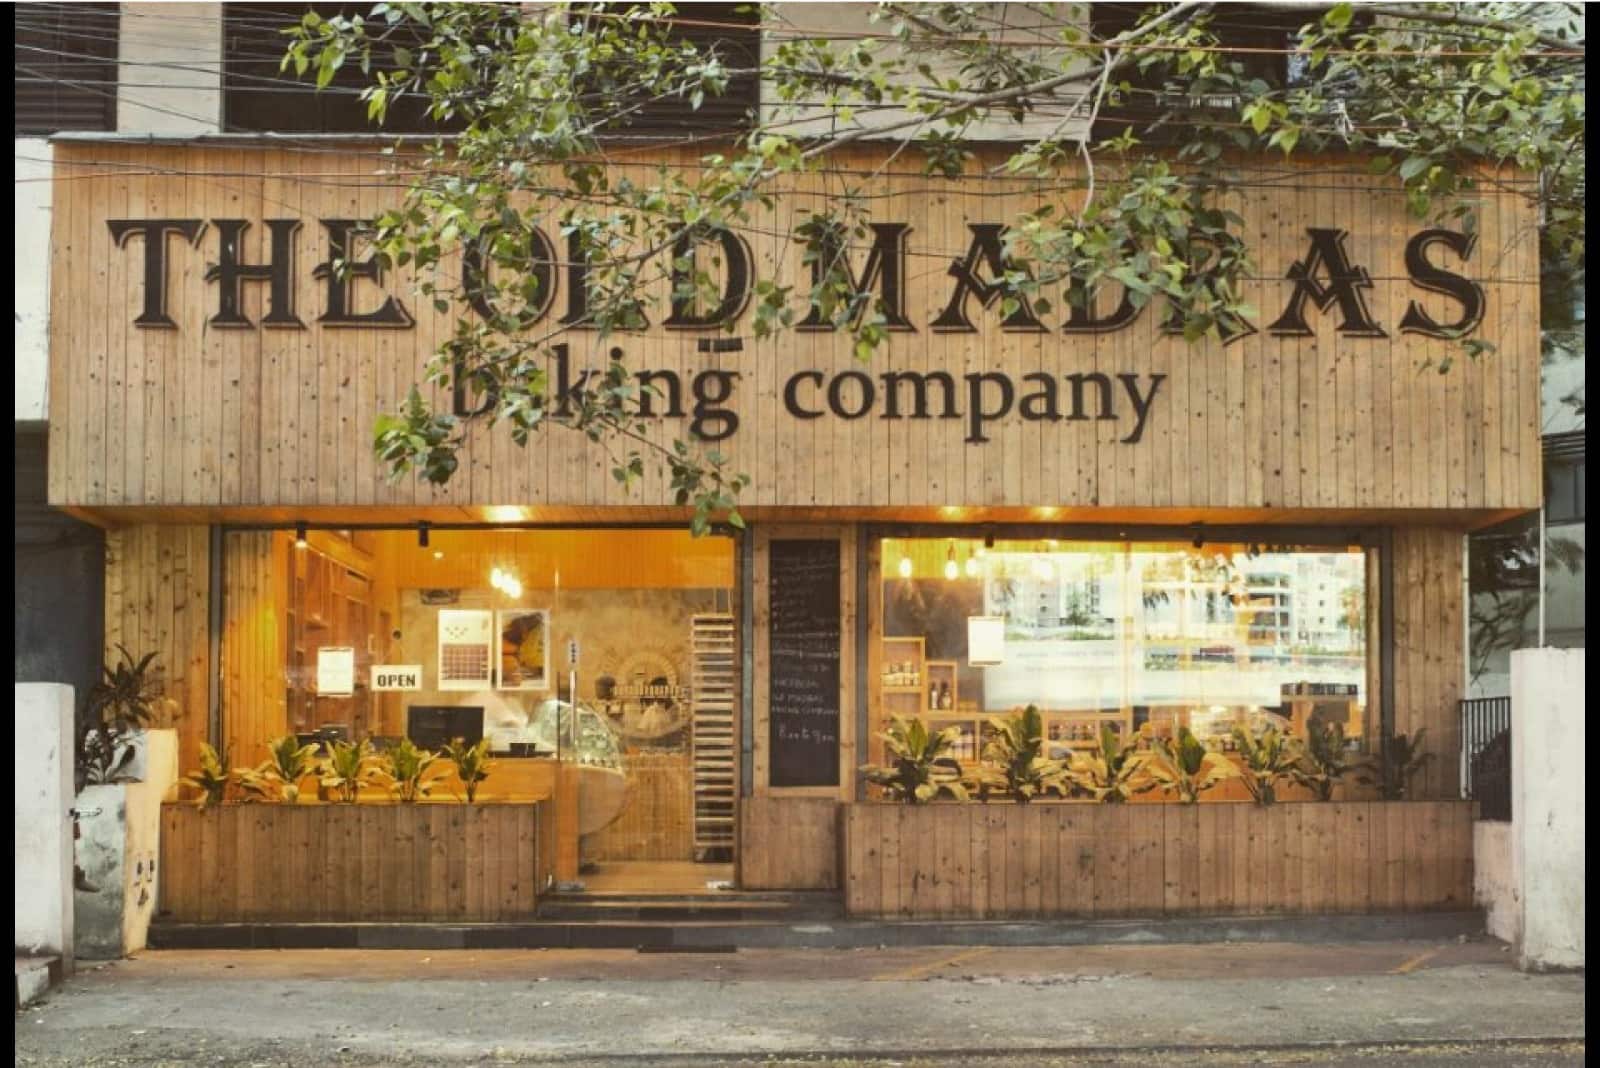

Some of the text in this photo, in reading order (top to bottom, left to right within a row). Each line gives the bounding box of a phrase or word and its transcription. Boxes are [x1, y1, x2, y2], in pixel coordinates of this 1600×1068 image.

[105, 218, 417, 330] THE
[462, 220, 756, 332] OLD
[451, 341, 1167, 444] bking company
[377, 674, 416, 688] OPEN
